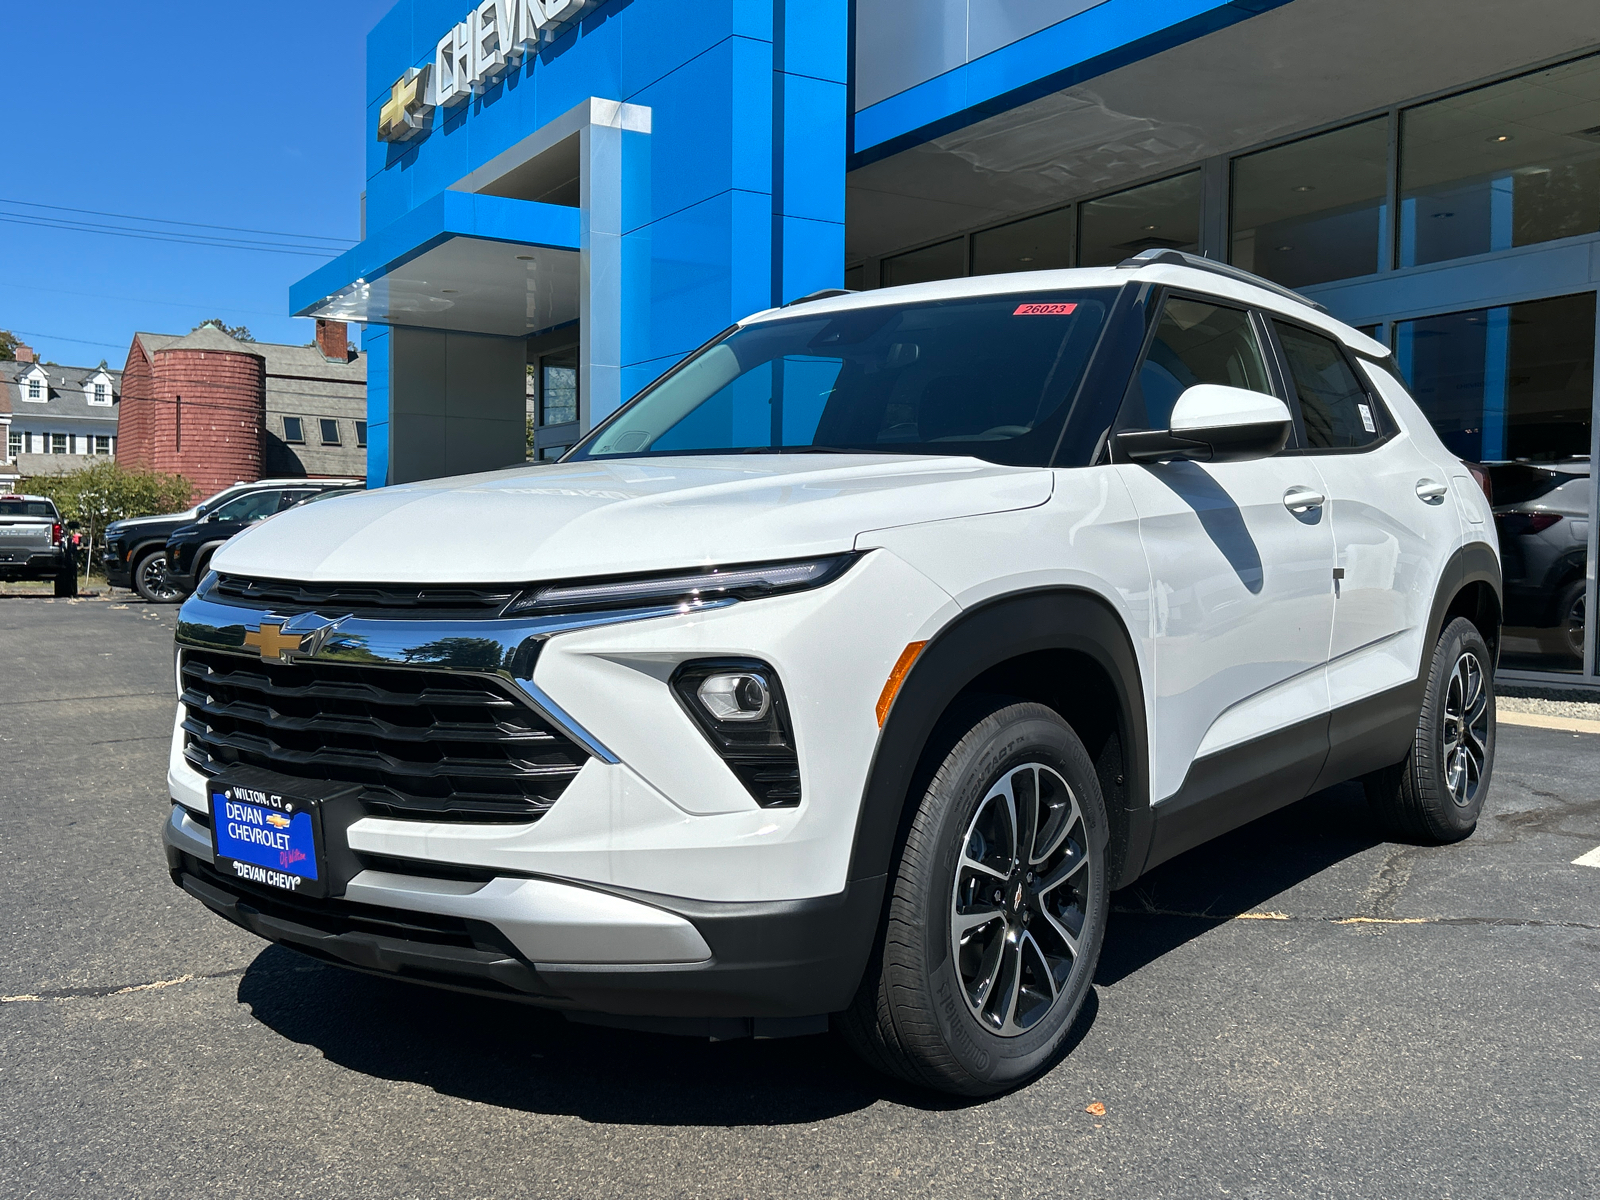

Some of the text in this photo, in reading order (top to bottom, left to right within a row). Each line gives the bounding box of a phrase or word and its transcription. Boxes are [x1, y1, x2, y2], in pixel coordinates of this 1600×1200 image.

[435, 0, 585, 107] CHEVR
[1022, 304, 1067, 314] 26023
[233, 786, 283, 808] WILTON, CT
[225, 802, 264, 826] DEVAN
[228, 822, 291, 851] CHEVROLET
[237, 862, 298, 891] DEVAN CHEVY
